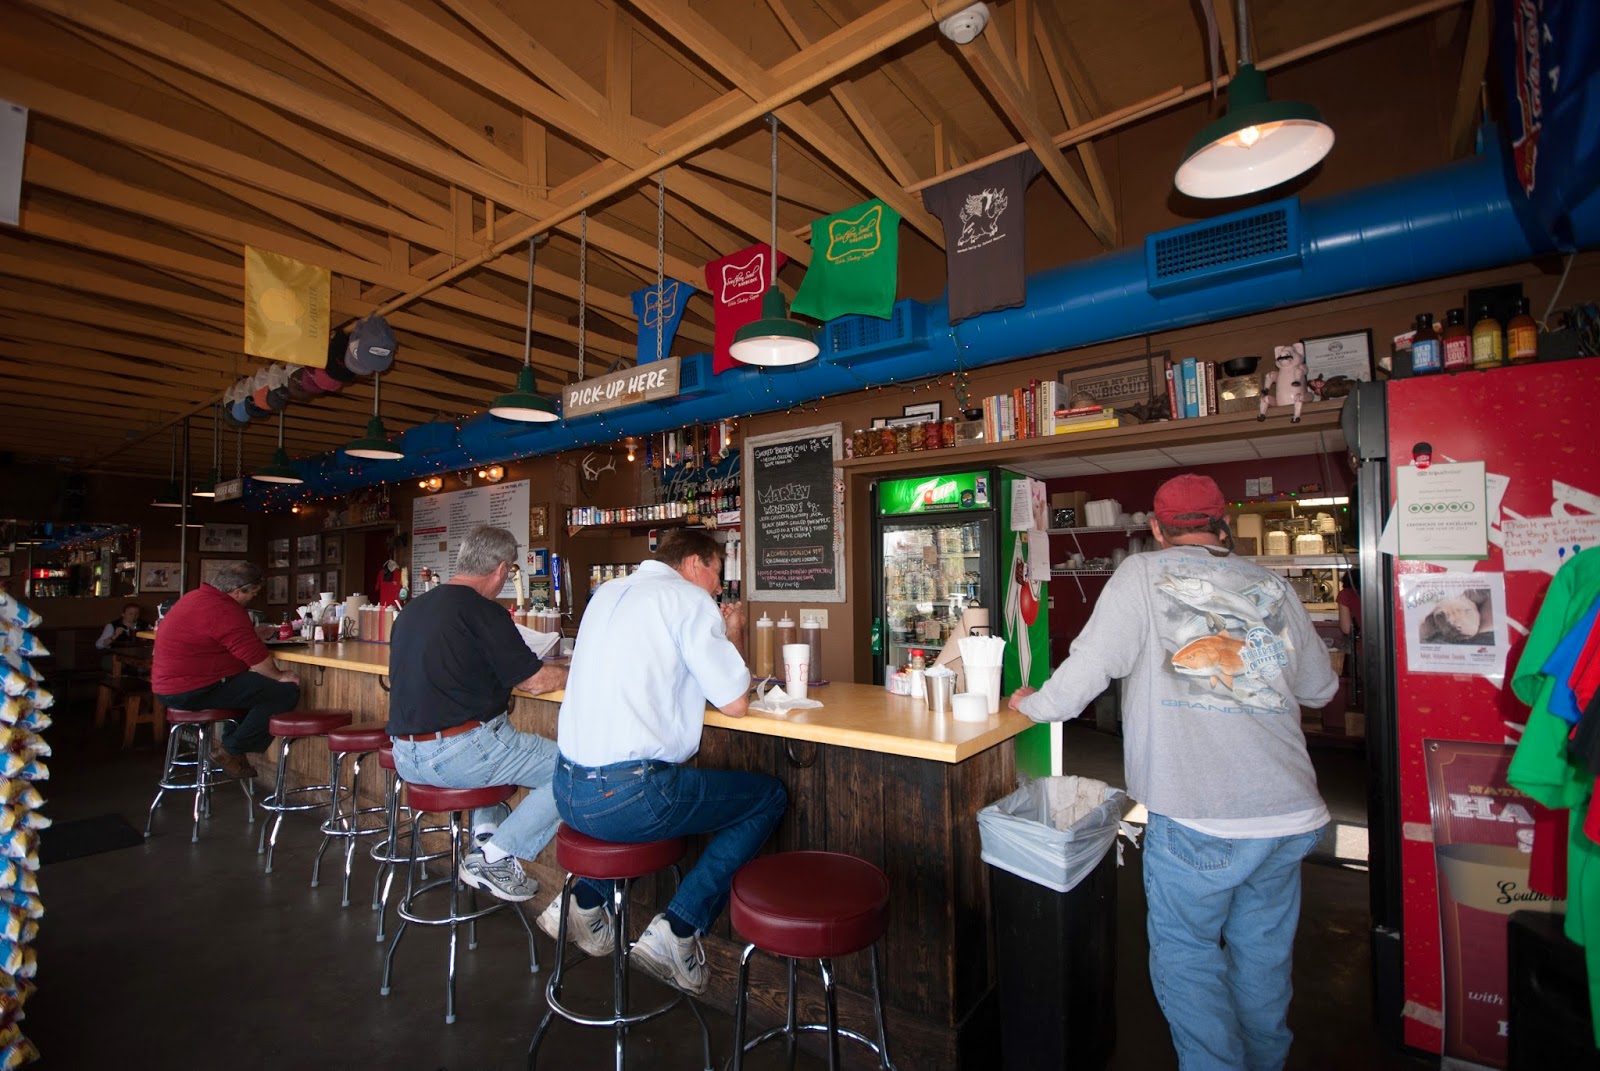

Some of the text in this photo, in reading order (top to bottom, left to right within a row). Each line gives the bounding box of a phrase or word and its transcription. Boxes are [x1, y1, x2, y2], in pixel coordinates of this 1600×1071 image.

[570, 368, 668, 408] PICK-UP HERE
[758, 483, 810, 504] MARLEY
[1468, 991, 1504, 1005] with
